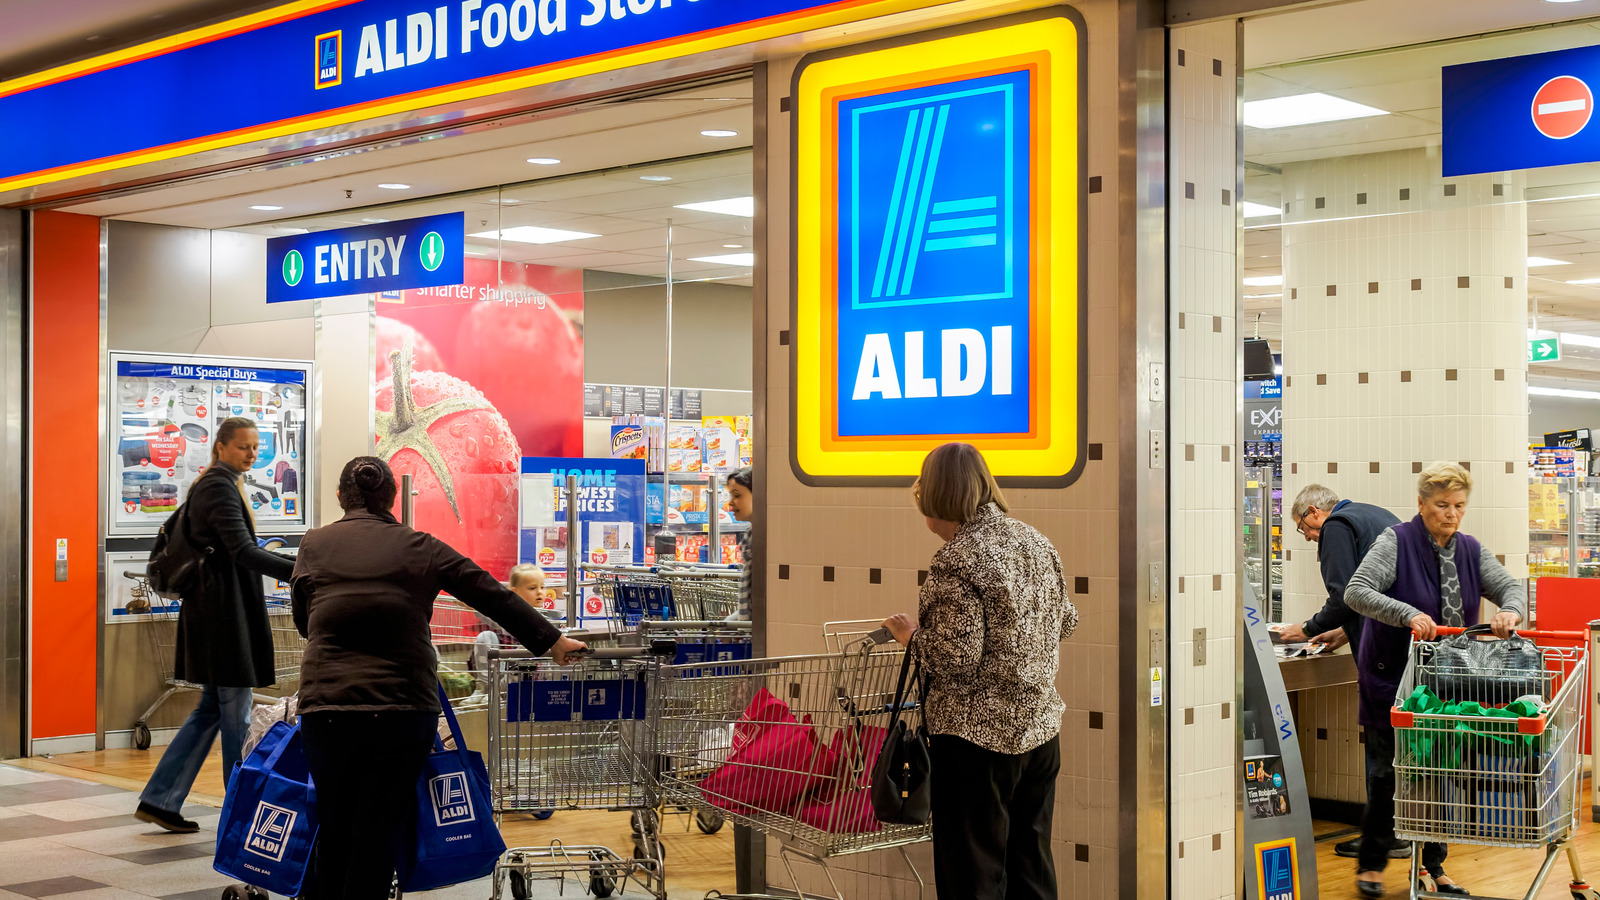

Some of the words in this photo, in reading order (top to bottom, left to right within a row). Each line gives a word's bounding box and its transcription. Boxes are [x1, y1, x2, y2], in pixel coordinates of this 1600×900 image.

[354, 6, 448, 78] ALDI
[461, 0, 567, 54] Food
[320, 67, 337, 79] ALDI
[314, 234, 407, 285] ENTRY
[416, 284, 475, 299] smarter
[479, 280, 546, 309] shopping
[852, 325, 1013, 400] ALDI
[171, 365, 194, 376] ALDI
[195, 366, 231, 380] Special
[233, 369, 257, 381] Buys
[1260, 379, 1277, 387] witch
[551, 469, 616, 486] HOME
[560, 487, 616, 499] LWEST
[646, 494, 660, 505] STA
[442, 805, 468, 820] ALDI
[250, 836, 280, 854] ALDI
[244, 863, 260, 873] COOLER
[261, 868, 271, 876] BAG
